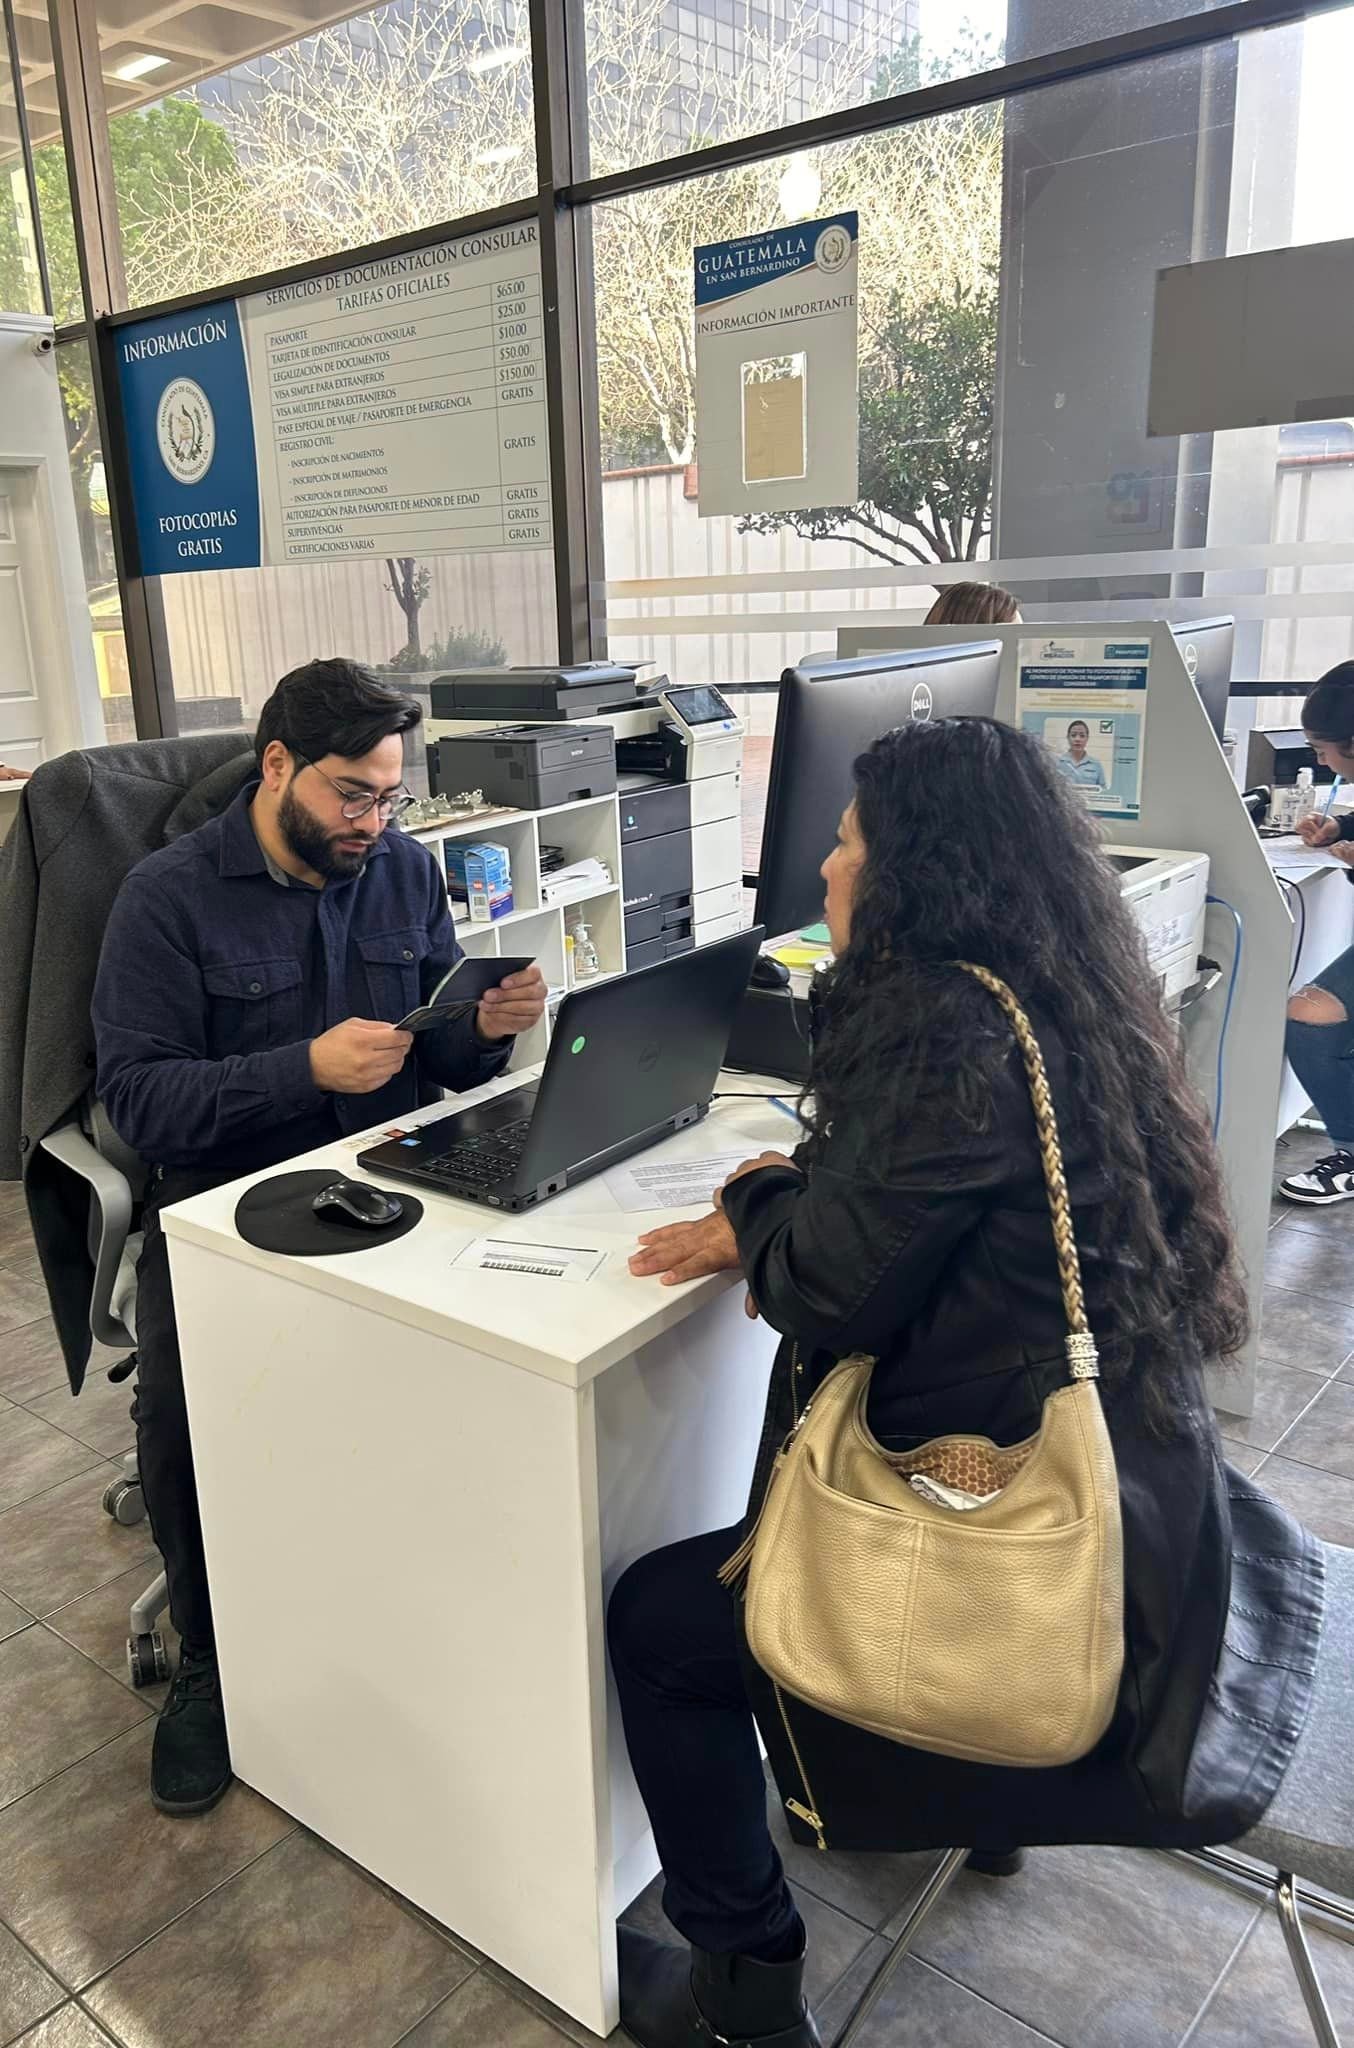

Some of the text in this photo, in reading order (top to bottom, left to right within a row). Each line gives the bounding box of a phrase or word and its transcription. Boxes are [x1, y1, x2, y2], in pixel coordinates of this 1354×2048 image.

[698, 237, 807, 274] GUATEMALA
[266, 226, 537, 306] SERVICIOS DE DOCUMENTACIÓN CONSULAR
[706, 257, 801, 285] EN SAN BERNARDINO
[336, 272, 450, 311] TARIFAS OFICIALES
[497, 280, 525, 298] $65.00
[498, 302, 526, 319] $25.00
[697, 294, 855, 334] INFORMACIÓN IMPORTANTE
[270, 330, 308, 347] PASAPORTE
[499, 323, 527, 340] $10.00
[124, 318, 227, 363] INFORMACIÓN
[272, 350, 300, 364] TARJETA
[301, 347, 311, 358] DE
[374, 326, 417, 344] CONSULAR
[500, 344, 530, 360] $50.00
[324, 360, 334, 371] DE
[336, 351, 390, 370] DOCUMENTOS
[500, 364, 535, 381] $150.00
[274, 371, 385, 399] VISA SIMPLE PARA EXTRANJEROS
[502, 386, 534, 400] GRATIS
[276, 406, 292, 417] VISA
[327, 398, 345, 409] PARA
[346, 388, 397, 406] EXTRANJEROS
[278, 423, 294, 435] PASE
[295, 417, 324, 432] ESPECIAL
[326, 415, 337, 427] DE
[337, 413, 357, 426] VIAJE
[362, 406, 404, 421] PASAPORTE
[406, 404, 417, 415] DE
[419, 396, 472, 413] EMERGENCIA
[280, 438, 313, 452] REGISTRO
[504, 436, 536, 449] GRATIS
[331, 453, 340, 463] DE
[341, 448, 385, 461] NACIMIENTOS
[332, 471, 341, 480] DE
[342, 466, 388, 480] MATRIMONIOS
[334, 489, 342, 498] DE
[343, 485, 388, 497] DEFUNCIONES
[506, 488, 538, 500] GRATIS
[340, 504, 358, 515] PARA
[359, 500, 399, 514] PASAPORTE
[400, 499, 411, 510] DE
[412, 497, 443, 509] MENOR
[444, 496, 455, 506] DE
[457, 493, 480, 505] EDAD
[159, 509, 238, 533] FOTOCOPIAS
[508, 508, 539, 520] GRATIS
[288, 524, 343, 537] SUPERVIVENCIAS
[509, 527, 540, 540] GRATIS
[178, 537, 223, 557] GRATIS
[289, 539, 375, 555] CERTIFICACIONES VARIAS
[913, 698, 930, 711] DELL
